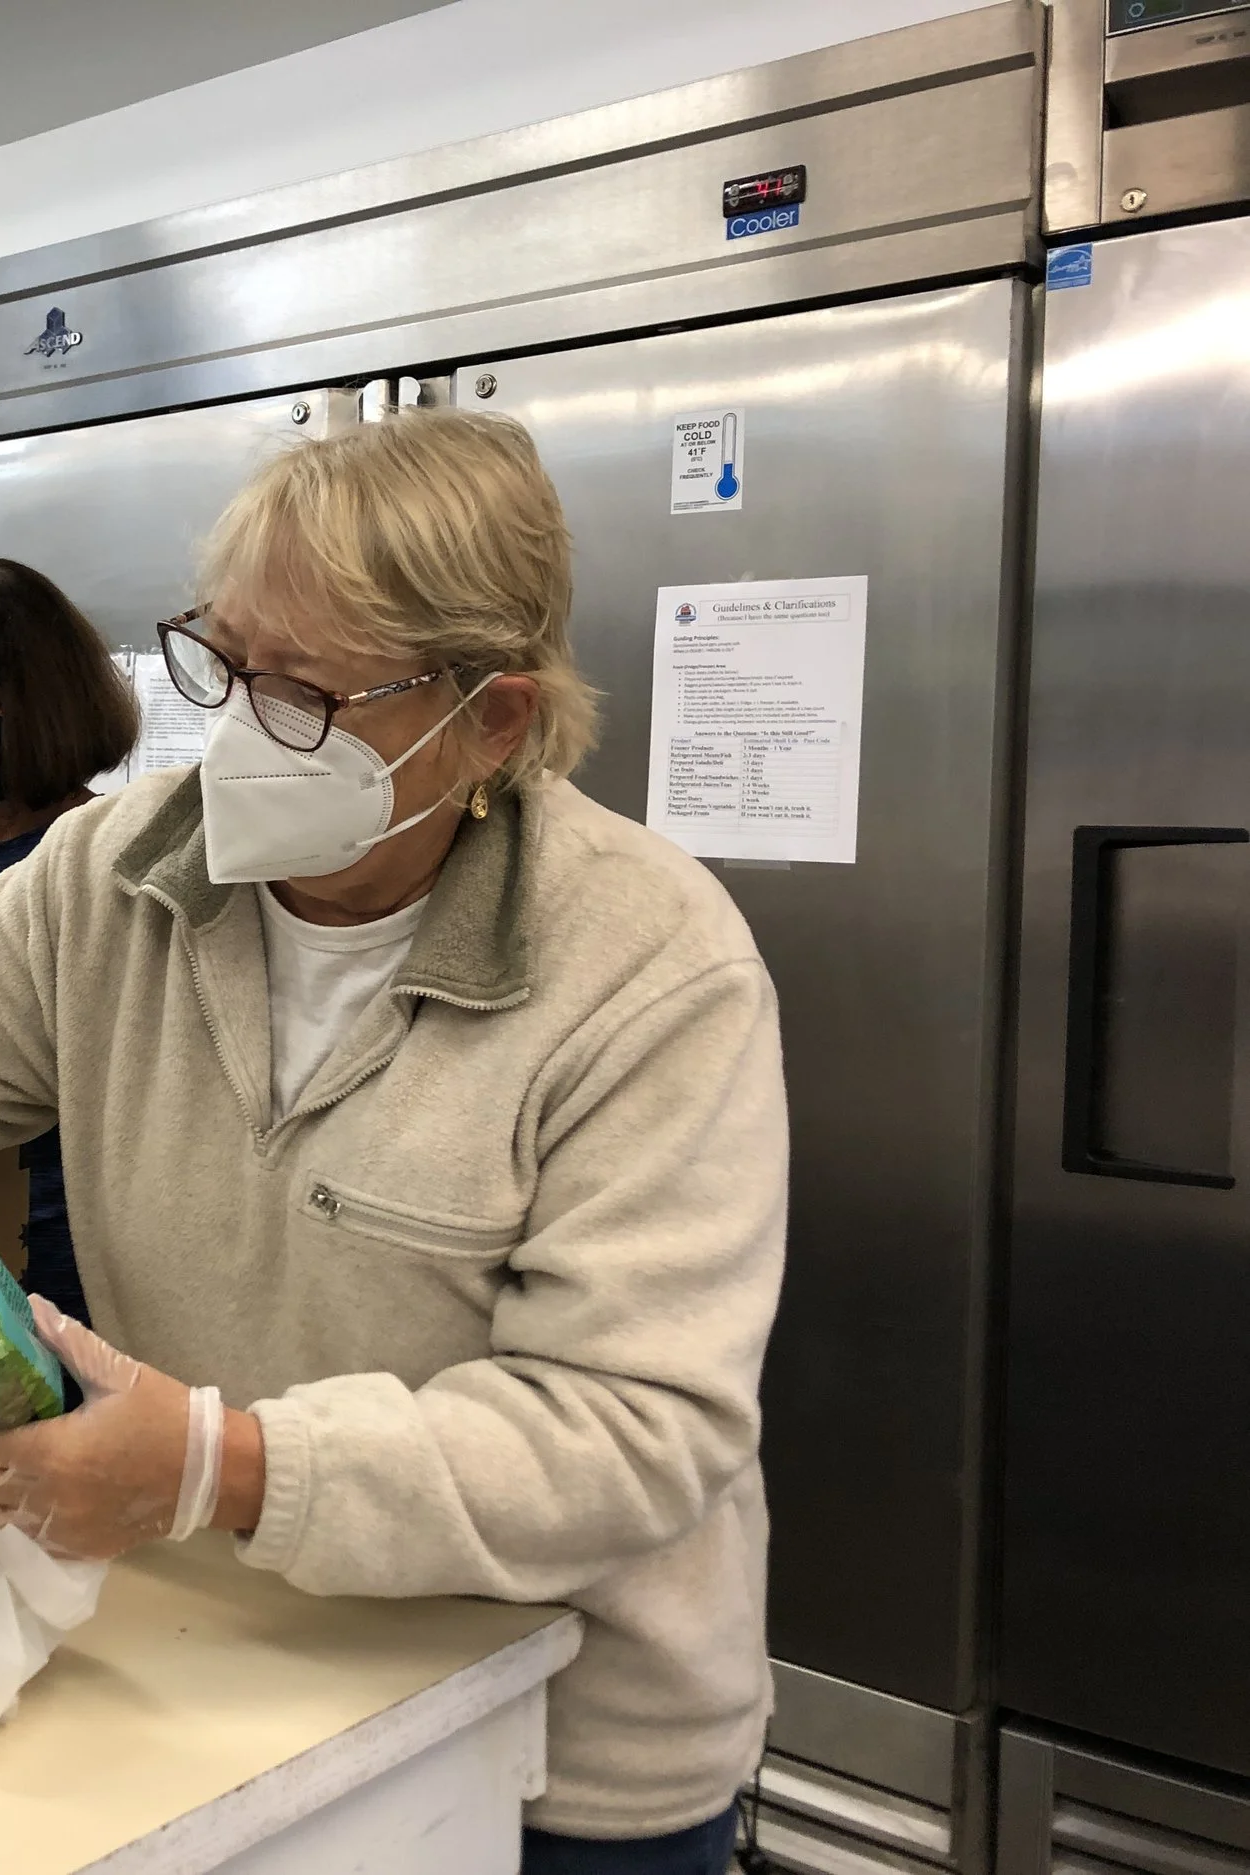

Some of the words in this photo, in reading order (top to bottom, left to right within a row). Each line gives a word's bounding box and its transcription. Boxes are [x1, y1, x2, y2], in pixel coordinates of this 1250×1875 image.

[730, 210, 796, 236] Cooler
[676, 423, 697, 431] KEEP
[698, 420, 720, 429] FOOD
[683, 430, 712, 441] COLD
[679, 472, 713, 480] FREQUENTLY
[712, 602, 760, 613] Guidelines
[763, 601, 771, 611] &
[774, 599, 836, 610] Clarifications
